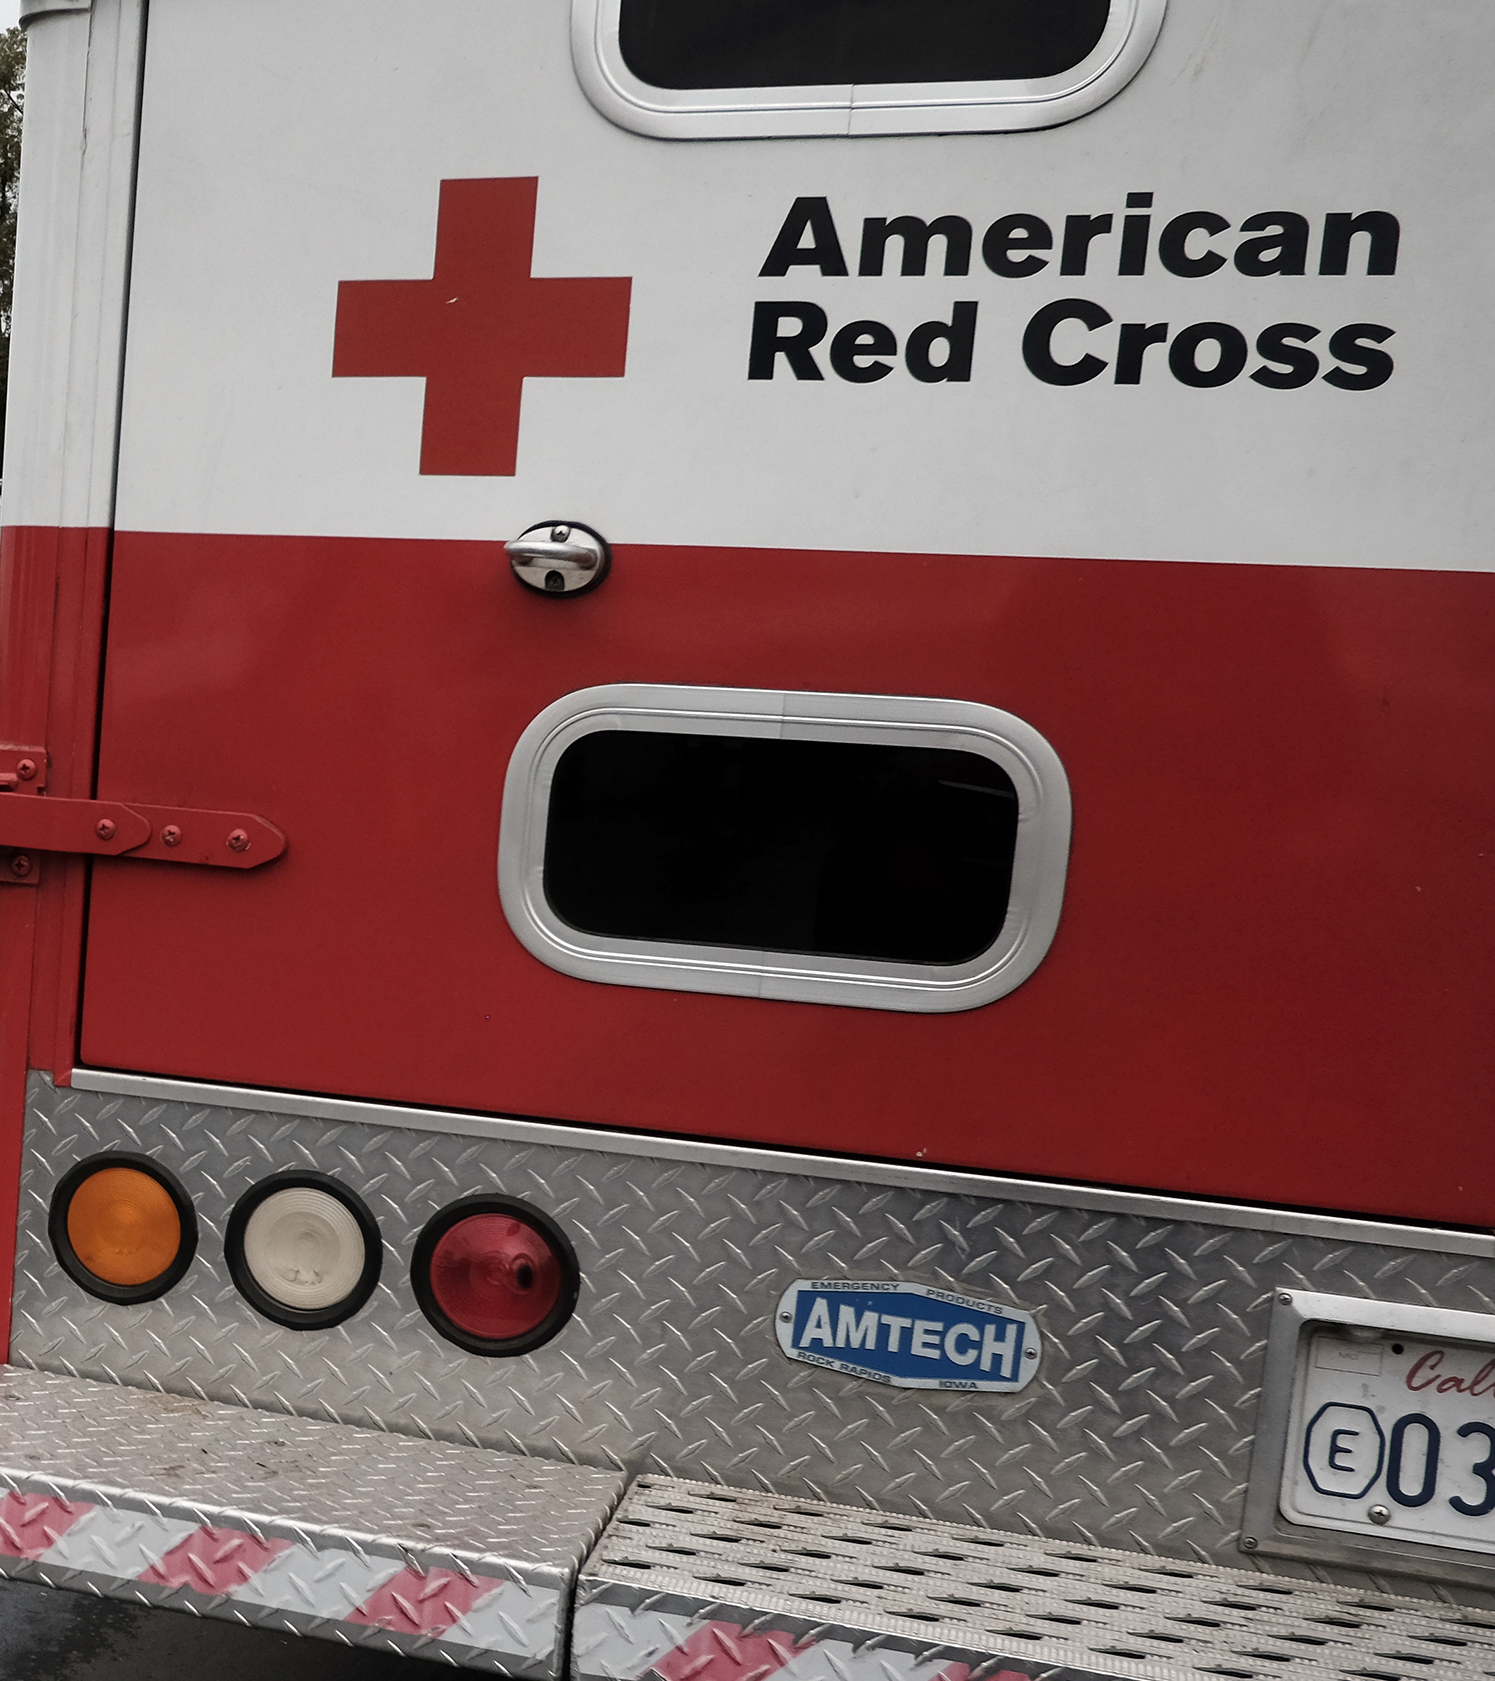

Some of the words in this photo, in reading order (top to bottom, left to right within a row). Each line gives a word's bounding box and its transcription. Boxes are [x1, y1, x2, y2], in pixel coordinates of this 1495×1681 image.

[758, 192, 1400, 279] American
[747, 300, 979, 383] Red
[1021, 298, 1396, 391] Cross
[811, 1282, 899, 1291] EMERGENCY
[926, 1289, 1003, 1315] PRODUCTS
[799, 1297, 1018, 1379] AMTECH
[797, 1351, 834, 1368] ROCK
[840, 1363, 892, 1383] RAPIDS
[939, 1381, 979, 1390] IOWA
[1407, 1350, 1495, 1398] Cal
